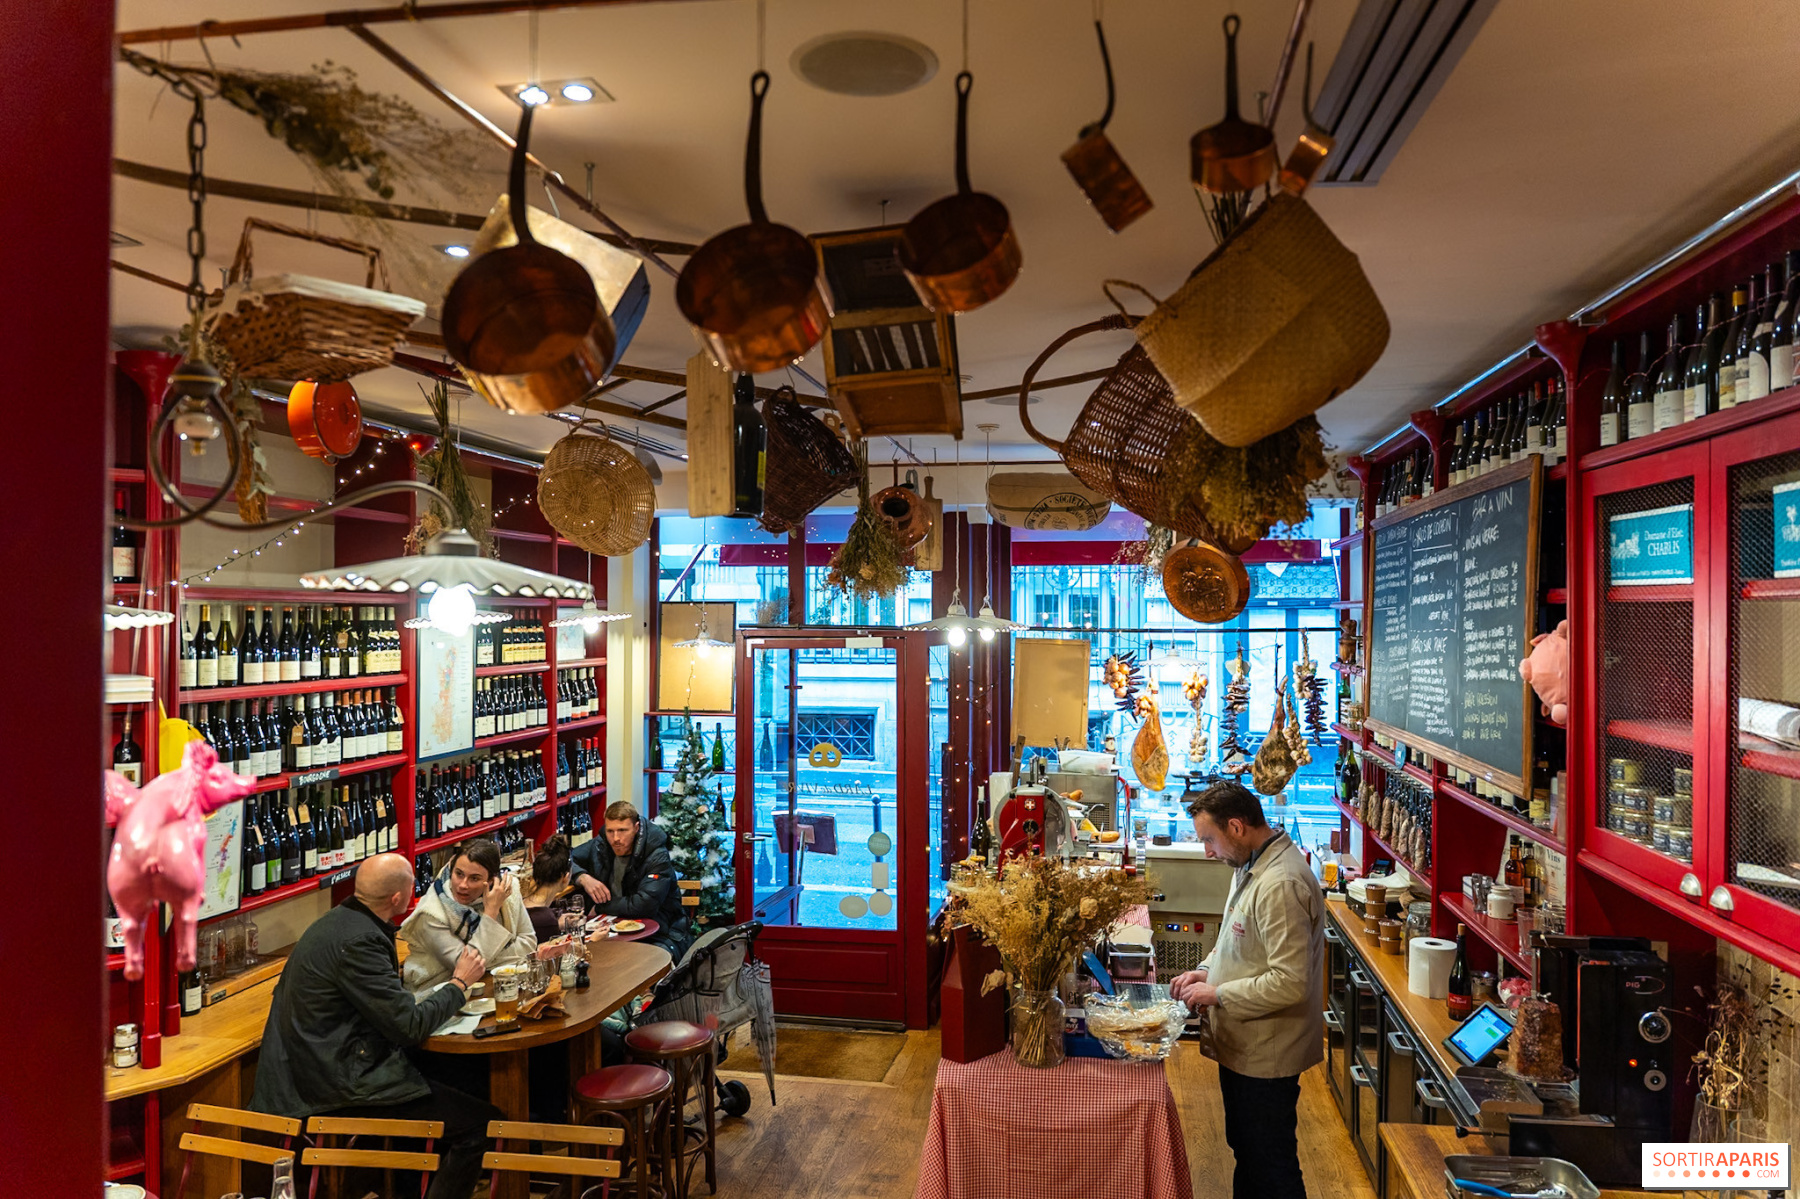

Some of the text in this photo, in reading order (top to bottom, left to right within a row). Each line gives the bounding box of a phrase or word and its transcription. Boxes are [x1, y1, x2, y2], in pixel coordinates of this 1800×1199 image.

[1496, 487, 1513, 512] VIN
[1647, 540, 1680, 557] CHABLIS
[1546, 848, 1561, 863] Vins
